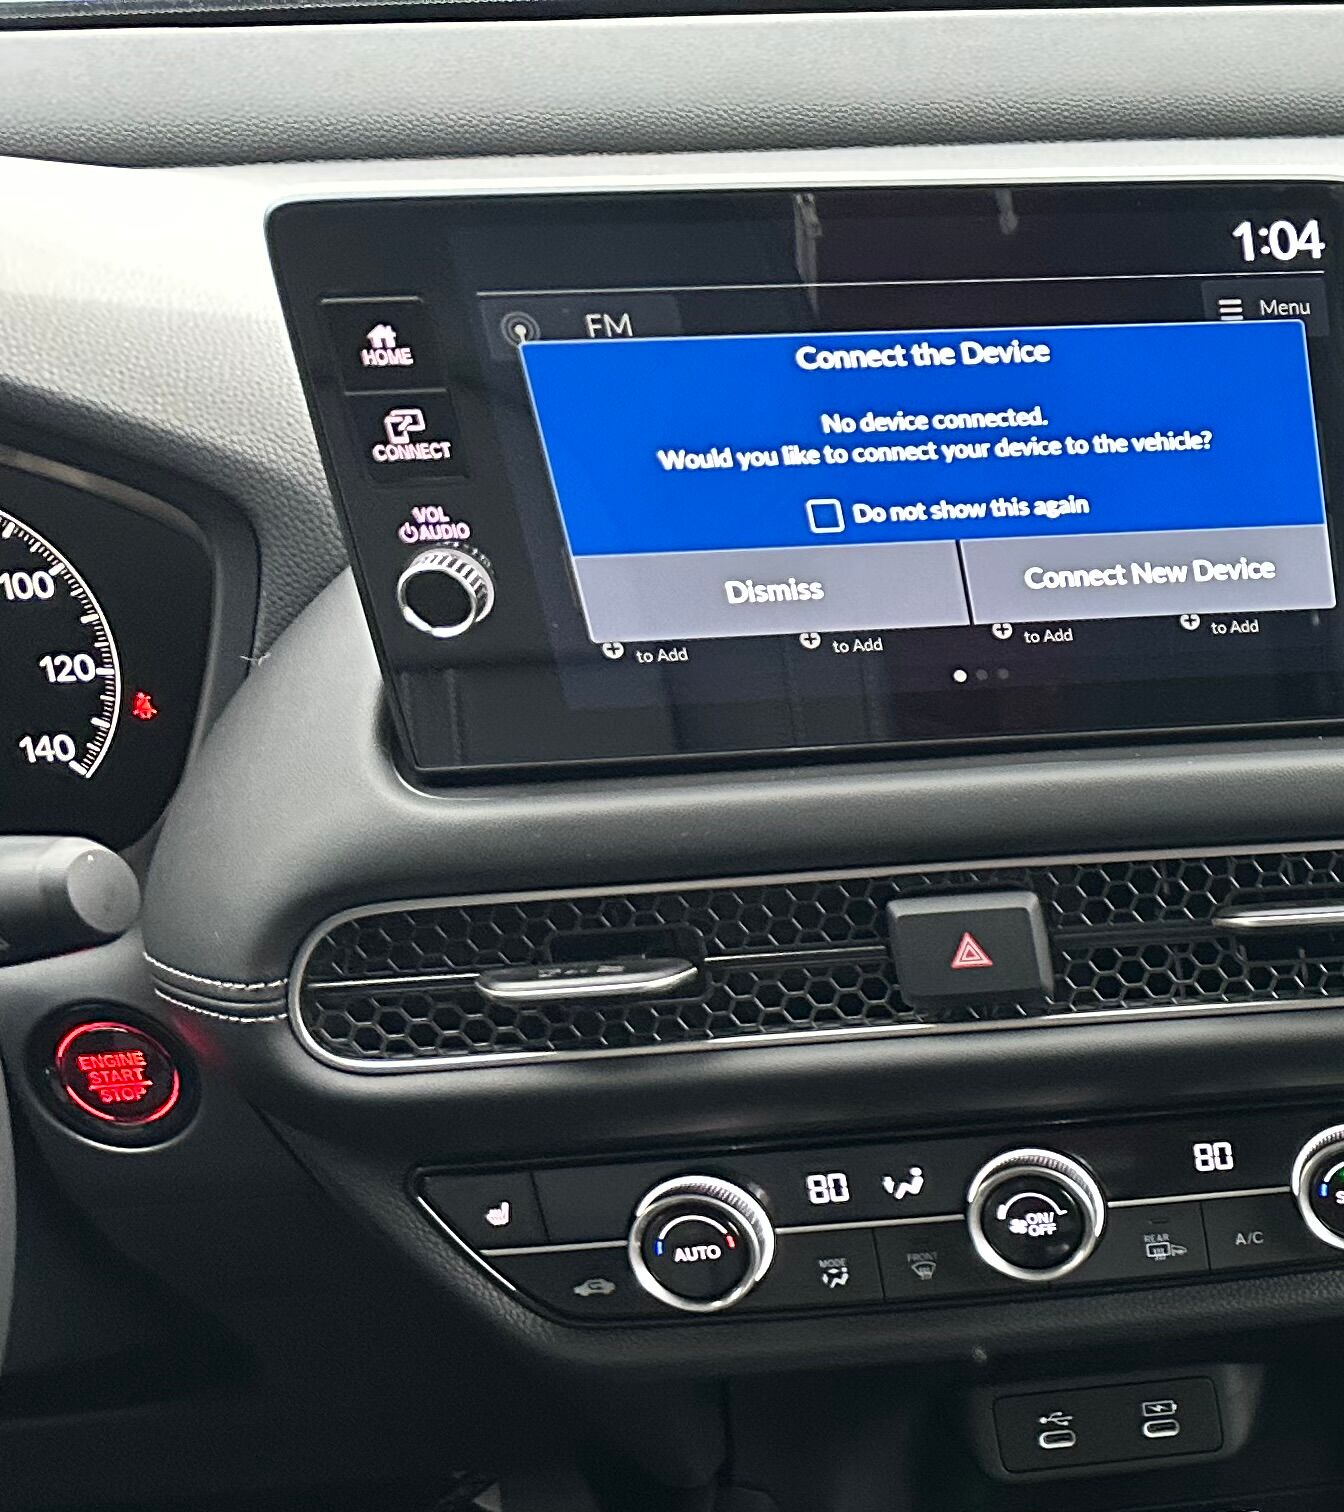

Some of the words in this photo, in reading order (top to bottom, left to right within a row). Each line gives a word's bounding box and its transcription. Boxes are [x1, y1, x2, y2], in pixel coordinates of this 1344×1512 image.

[1232, 219, 1325, 263] 1:04
[1259, 298, 1311, 317] Menu
[585, 313, 634, 338] FM
[361, 346, 413, 367] HOME
[795, 346, 906, 371] Connect
[912, 343, 957, 366] the
[961, 340, 1051, 365] Device
[822, 413, 857, 435] No
[860, 409, 929, 432] device
[931, 406, 1049, 430] connected.
[372, 441, 451, 461] CONNECT
[657, 448, 733, 471] Would
[736, 452, 778, 472] you
[782, 446, 820, 467] like
[824, 445, 849, 464] to
[852, 443, 939, 464] connect
[941, 441, 991, 462] your
[994, 436, 1062, 458] device
[1065, 436, 1090, 457] to
[1092, 433, 1129, 455] the
[1131, 430, 1213, 453] vehicle?
[412, 506, 449, 524] VOL
[852, 502, 887, 524] Do
[890, 502, 926, 522] not
[929, 498, 987, 521] show
[991, 496, 1031, 519] this
[1034, 495, 1090, 518] again
[417, 521, 470, 541] AUDIO
[1024, 564, 1128, 589] Connect
[1132, 561, 1188, 585] New
[1193, 557, 1276, 582] Device
[0, 571, 55, 601] 100
[724, 577, 825, 604] Dismiss
[1023, 629, 1043, 645] to
[1045, 627, 1074, 645] Add
[1210, 620, 1230, 636] to
[1231, 618, 1260, 635] Add
[832, 638, 851, 653] to
[853, 636, 884, 653] Add
[635, 648, 655, 664] to
[656, 646, 689, 664] Add
[39, 652, 97, 683] 120
[19, 733, 76, 763] 140
[77, 1051, 146, 1070] ENGINE
[87, 1068, 145, 1084] START
[100, 1086, 146, 1103] STOP
[1193, 1141, 1234, 1172] 80
[806, 1172, 850, 1204] 80
[1026, 1211, 1054, 1226] ON/
[1027, 1223, 1057, 1237] OFF
[1144, 1233, 1170, 1244] REAR
[1235, 1231, 1264, 1247] A/C
[674, 1244, 722, 1262] AUTO
[907, 1252, 938, 1264] FRONT
[818, 1257, 847, 1271] MODE
